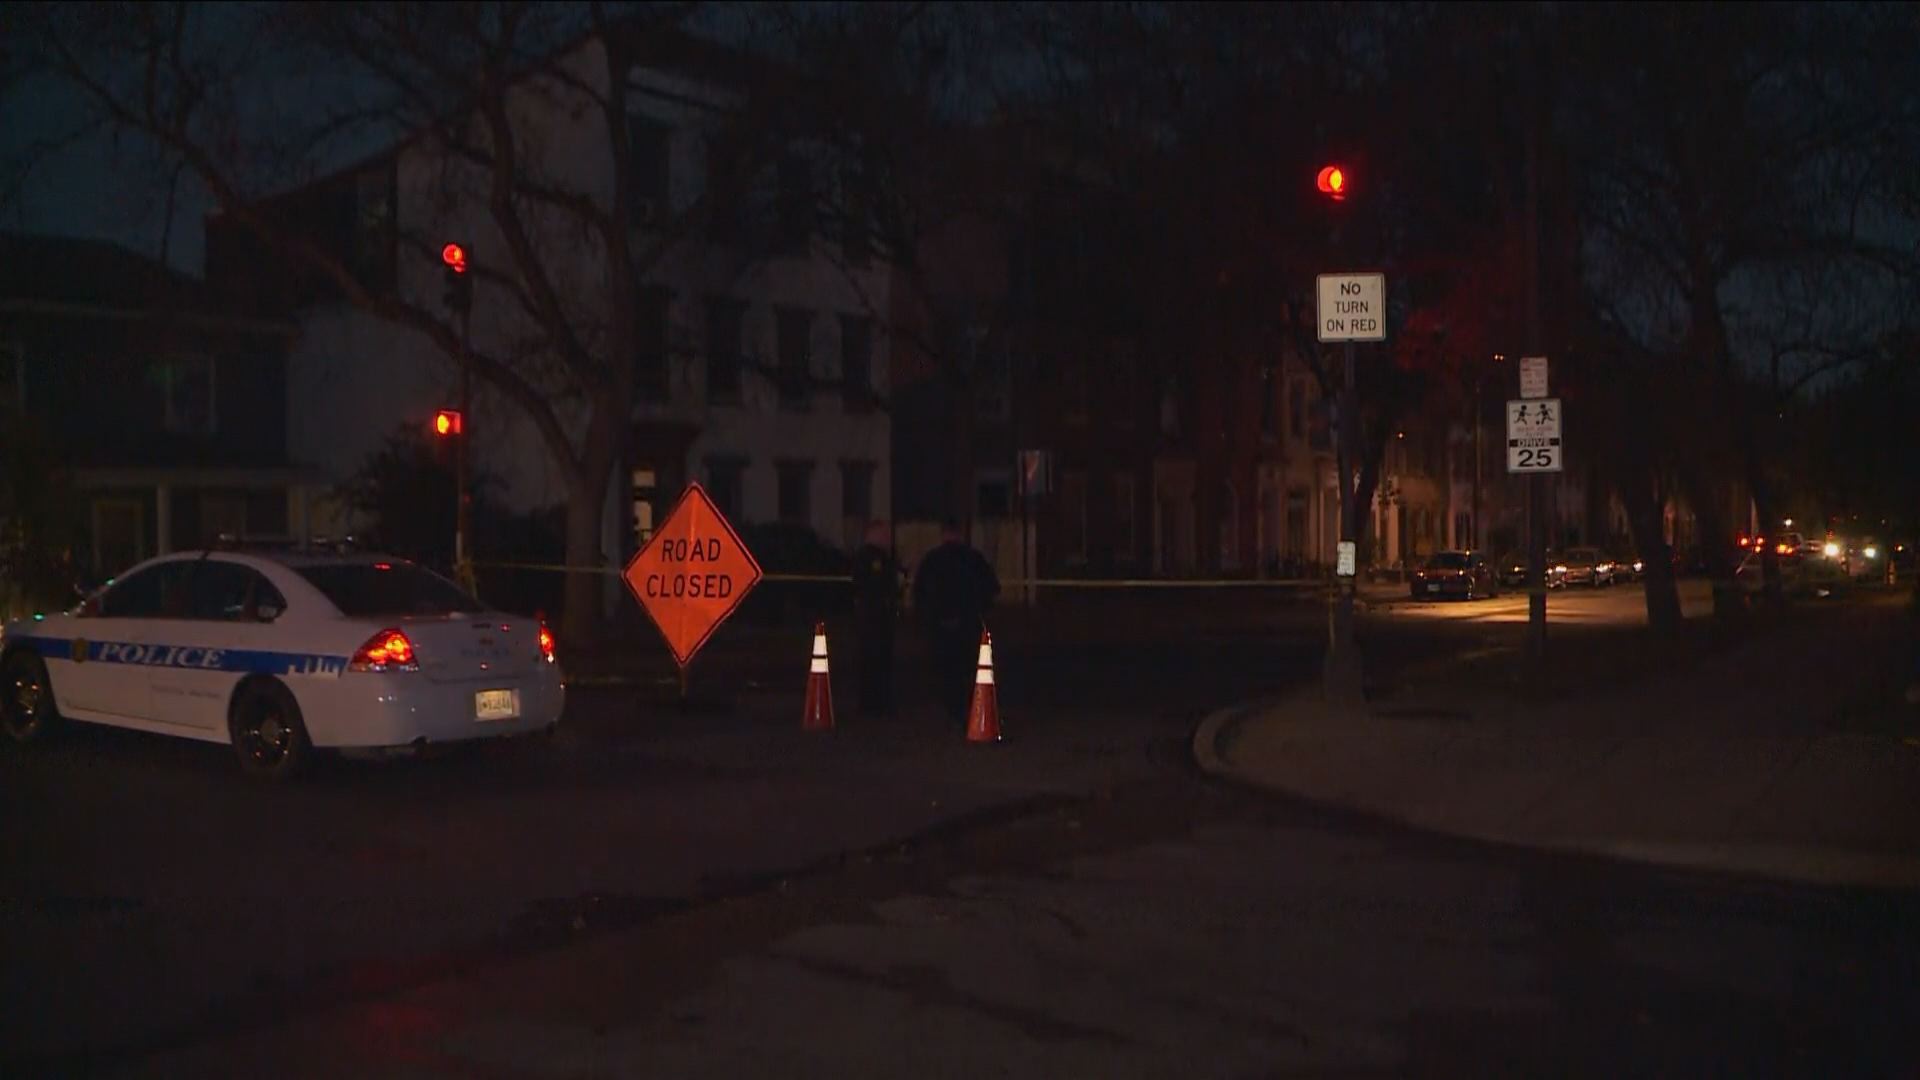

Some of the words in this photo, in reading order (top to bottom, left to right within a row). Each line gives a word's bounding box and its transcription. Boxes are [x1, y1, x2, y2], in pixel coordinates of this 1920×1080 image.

[1340, 282, 1361, 296] NO
[1334, 301, 1369, 314] TURN
[1326, 319, 1344, 332] ON
[1351, 319, 1377, 332] RED
[1518, 449, 1552, 467] 25
[662, 538, 721, 562] ROAD
[646, 574, 732, 599] CLOSED
[98, 642, 226, 668] POLICE
